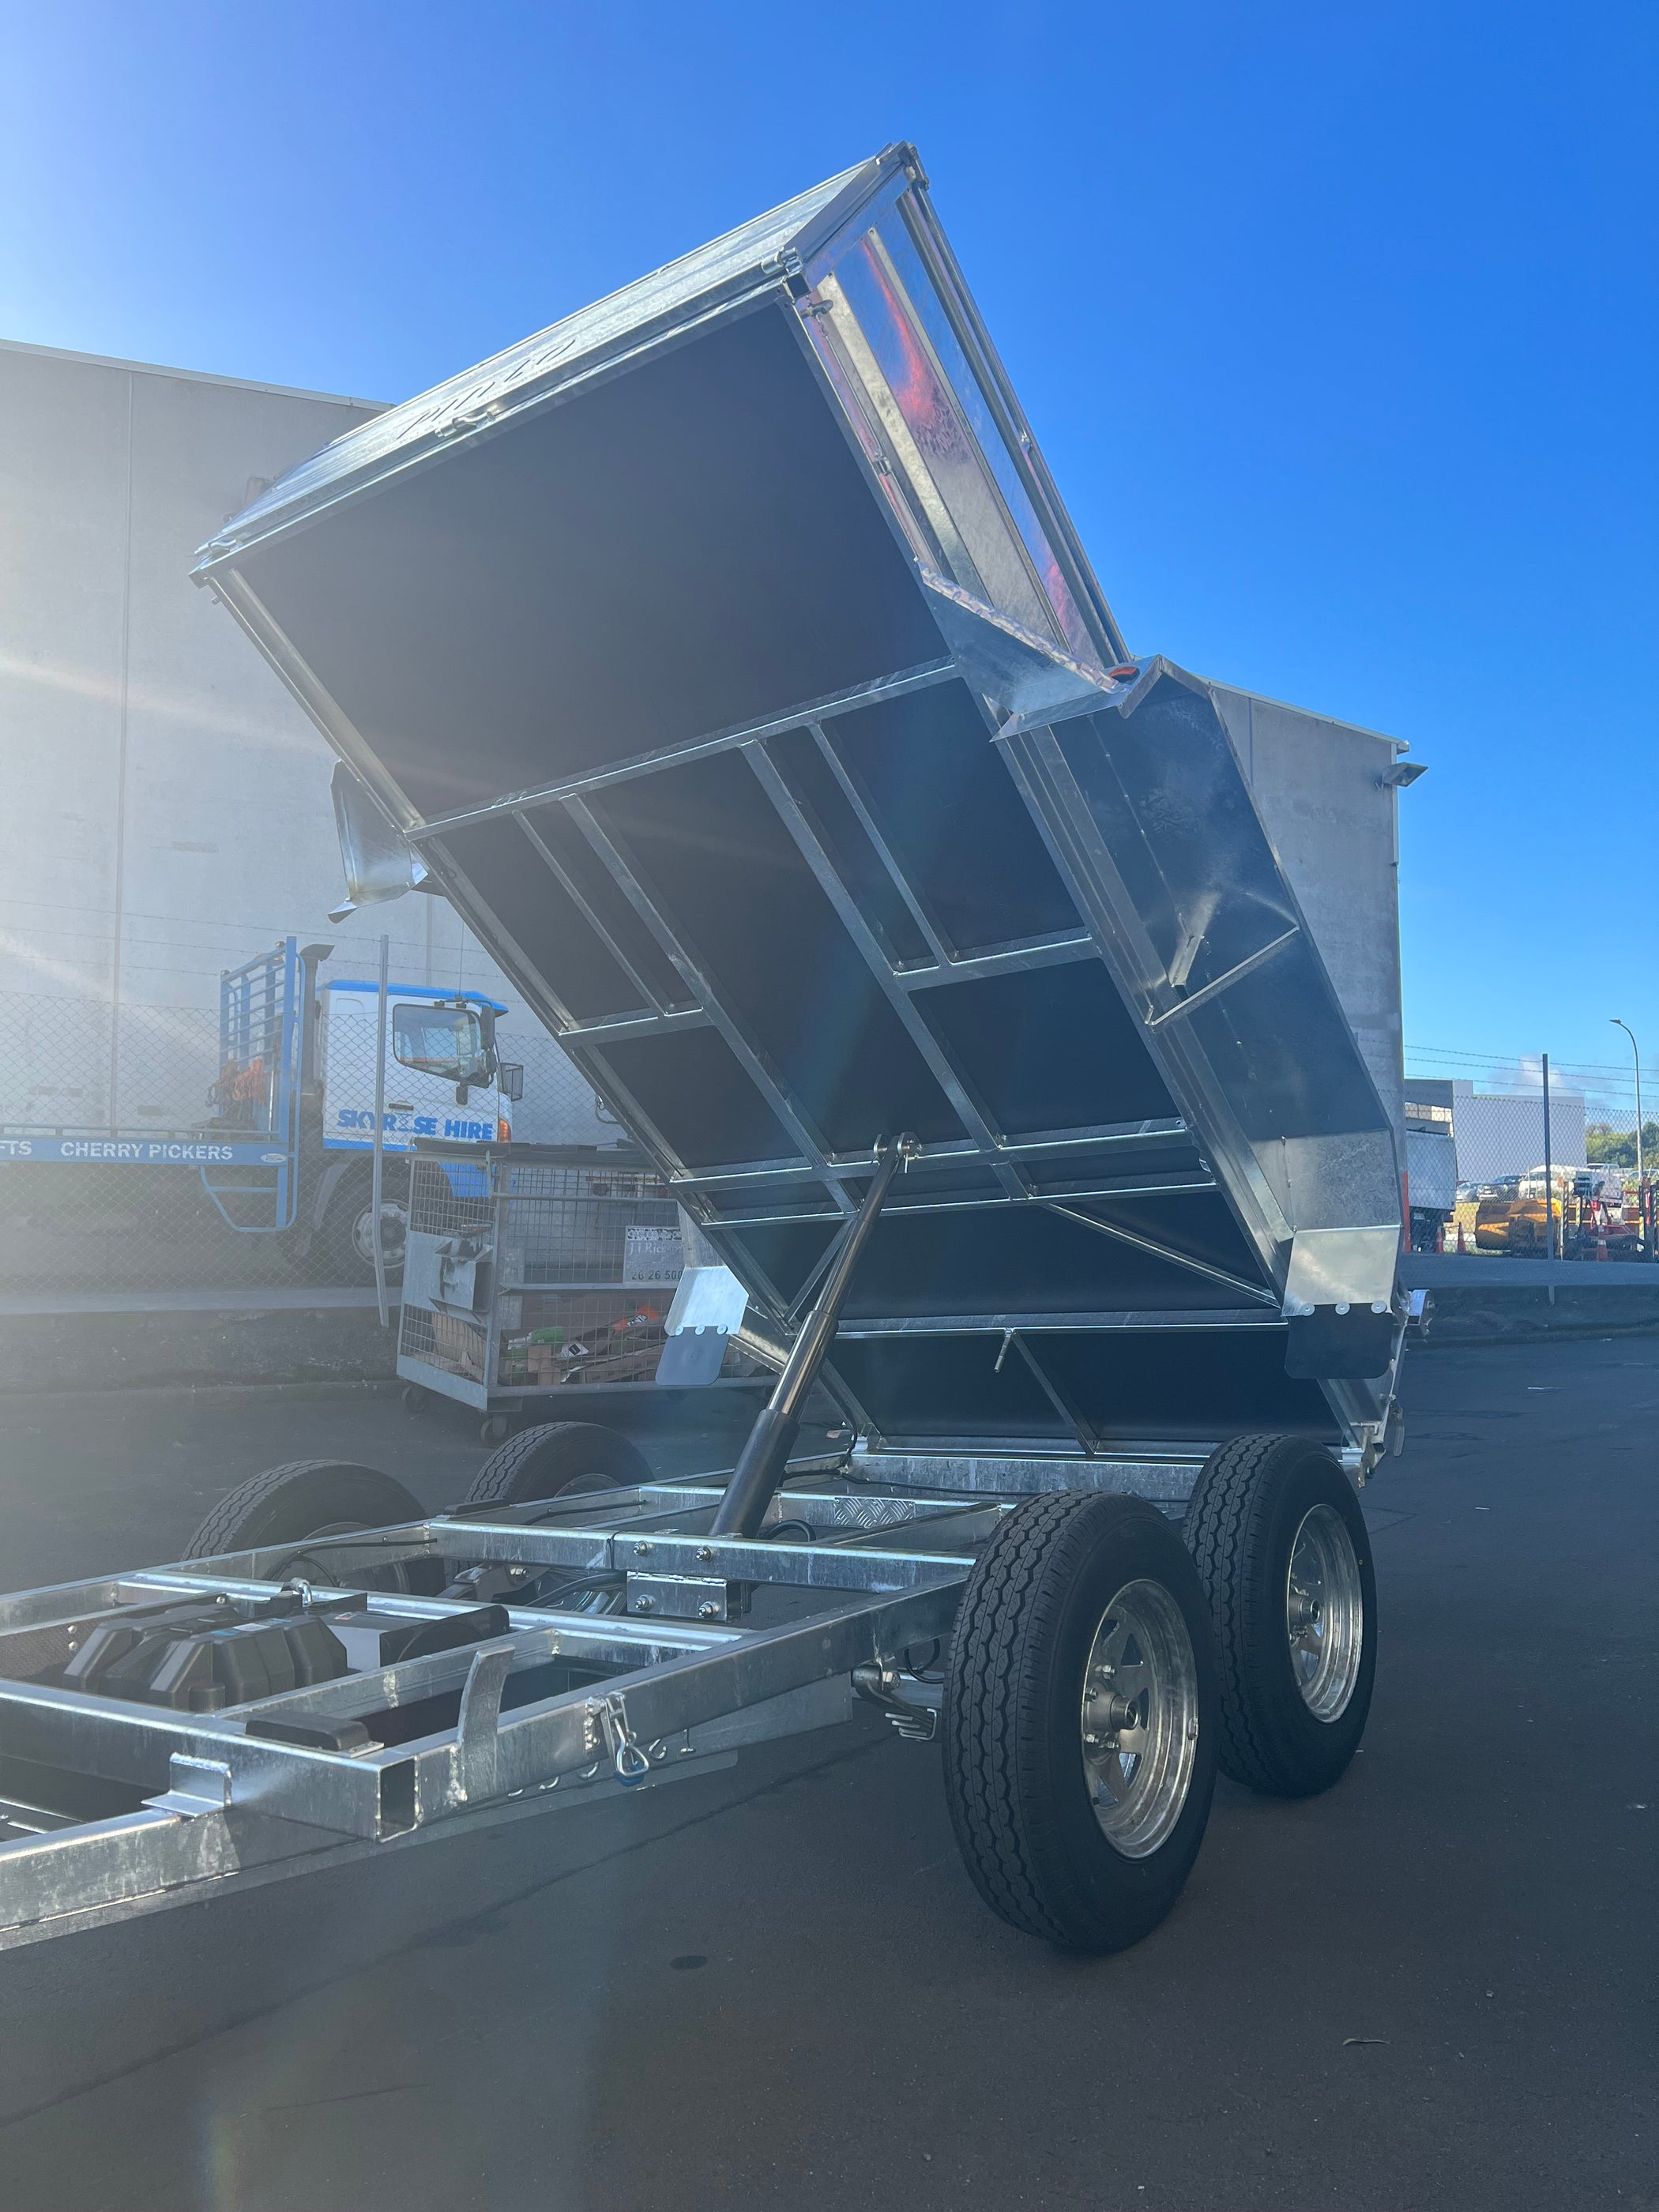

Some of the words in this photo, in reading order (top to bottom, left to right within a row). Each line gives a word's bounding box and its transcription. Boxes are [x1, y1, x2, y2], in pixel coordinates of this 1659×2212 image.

[444, 1119, 493, 1140] HIRE
[60, 1142, 143, 1157] CHERRY
[149, 1143, 233, 1161] PICKERS
[648, 1270, 661, 1281] 26
